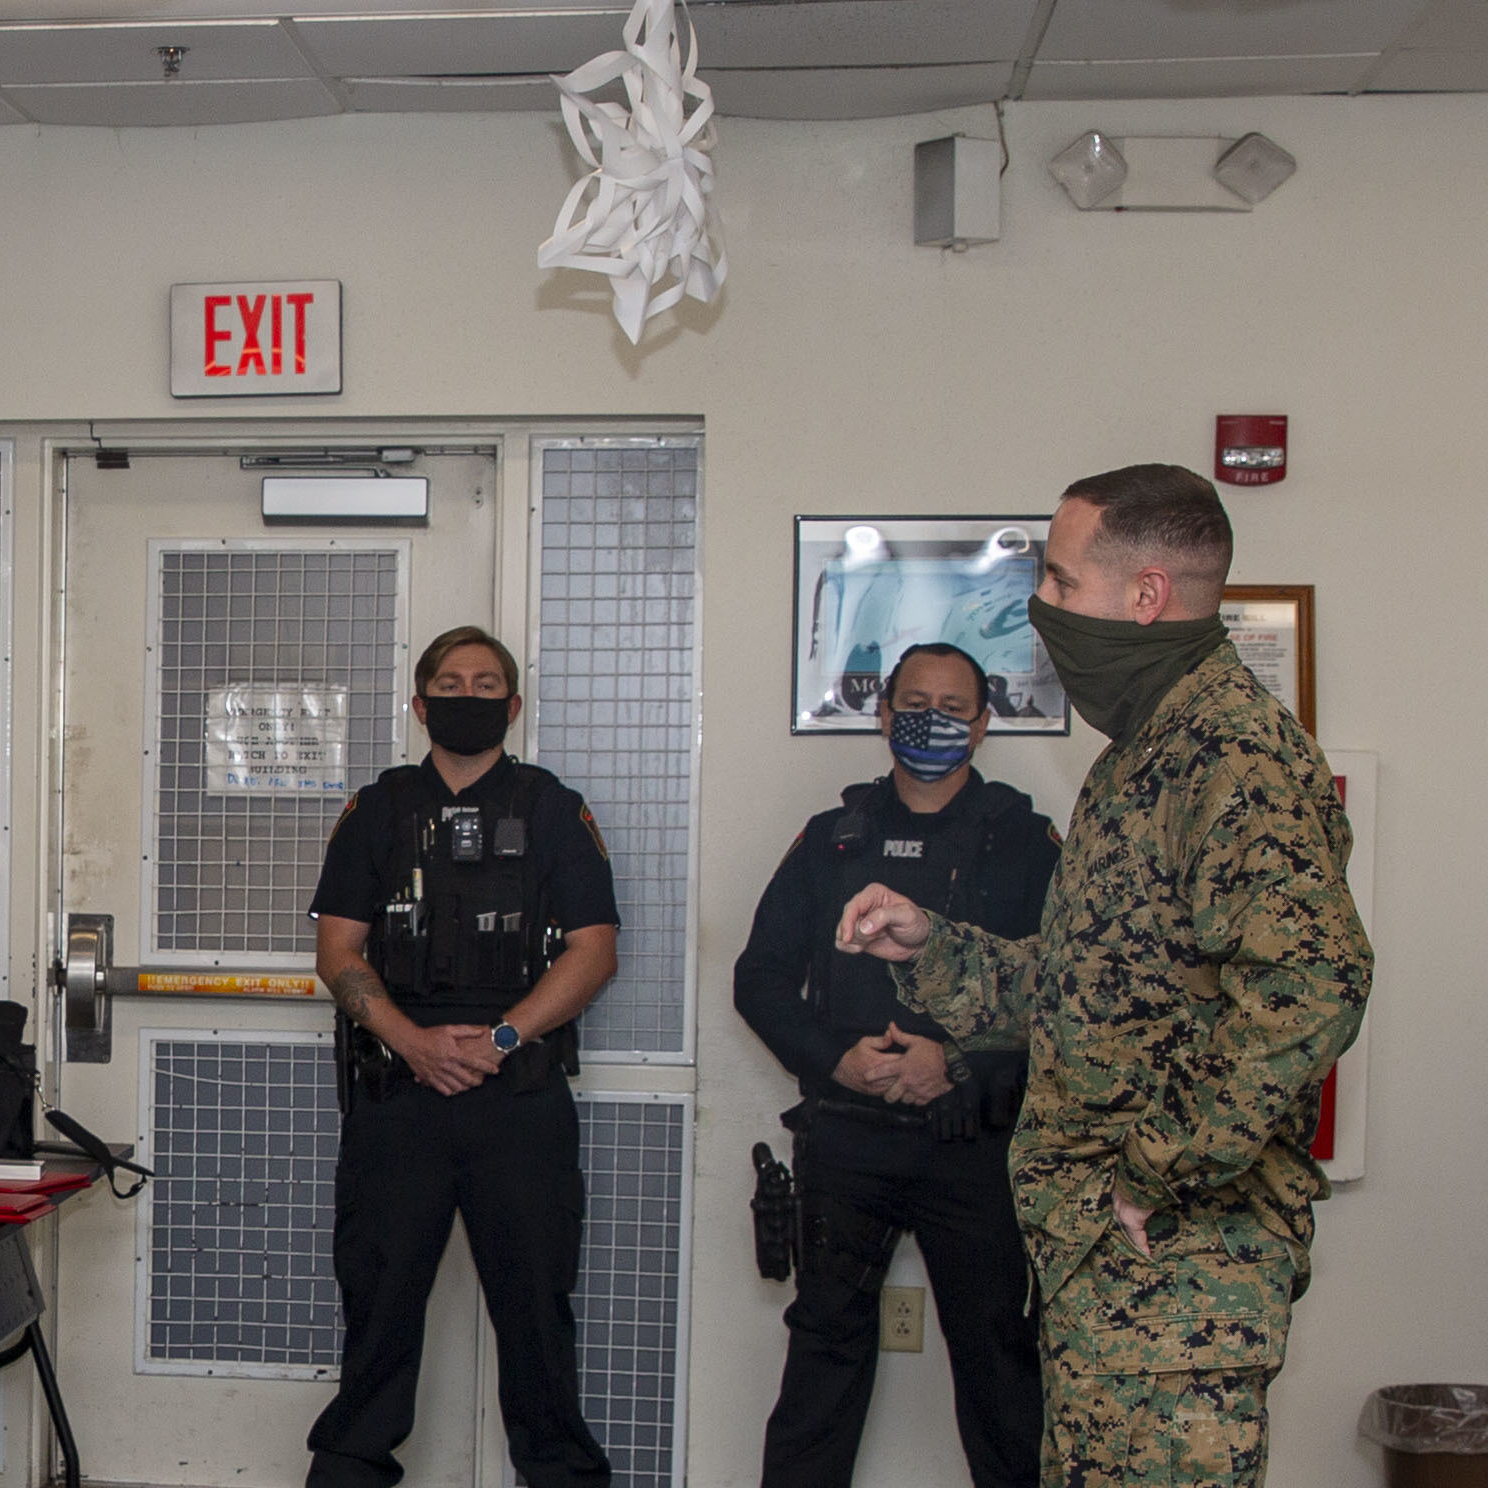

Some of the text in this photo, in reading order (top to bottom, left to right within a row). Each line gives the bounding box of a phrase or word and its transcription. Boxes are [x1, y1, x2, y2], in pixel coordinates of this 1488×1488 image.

[204, 293, 313, 376] EXIT
[1235, 472, 1269, 482] FIRE
[300, 707, 331, 717] EXT
[258, 722, 295, 732] ONY!
[265, 736, 319, 746] AOTHER
[228, 751, 265, 760] HTCH
[883, 839, 923, 858] POLICE
[236, 977, 262, 987] EXIT
